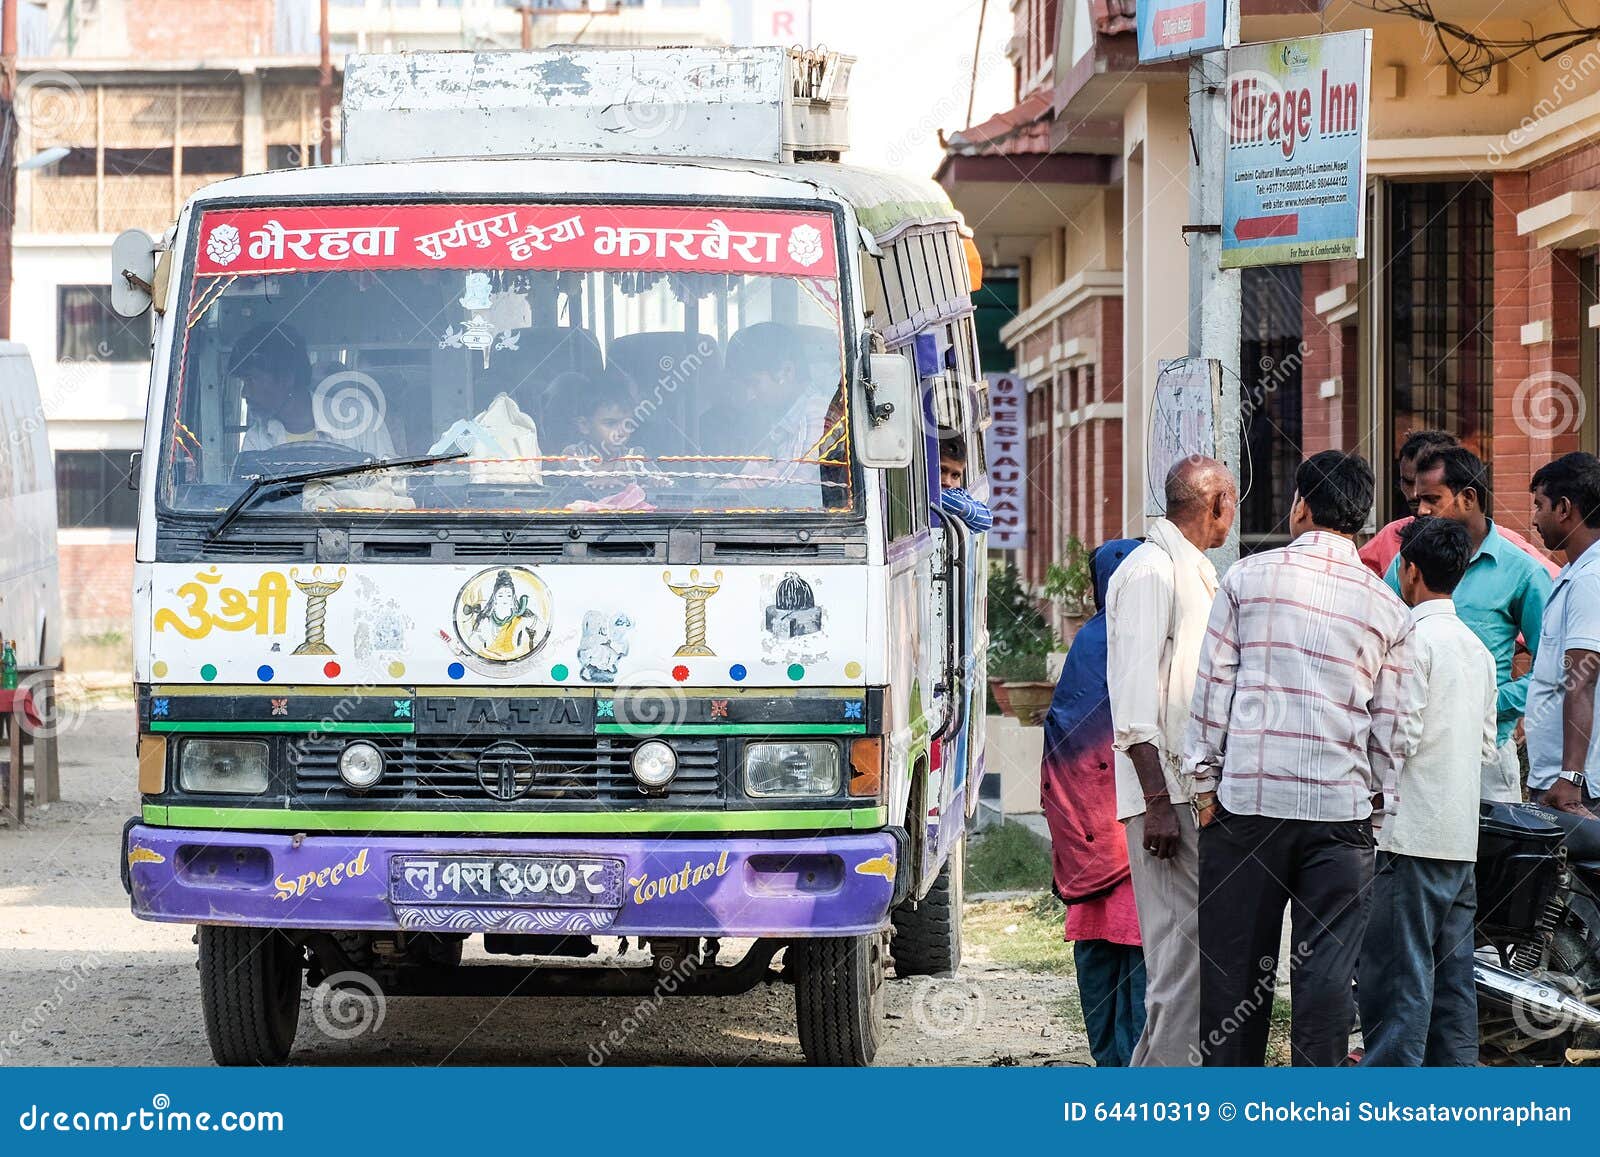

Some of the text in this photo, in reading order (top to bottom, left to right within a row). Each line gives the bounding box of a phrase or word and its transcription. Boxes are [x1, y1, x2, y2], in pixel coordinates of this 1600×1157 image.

[1230, 68, 1358, 158] Mirage Inn
[1235, 171, 1254, 182] Lumbini
[1254, 168, 1275, 180] Cultural
[248, 219, 400, 261] भैरहवा
[992, 396, 1020, 541] RESTAURANT
[426, 697, 582, 724] TATA
[273, 847, 370, 902] Speed
